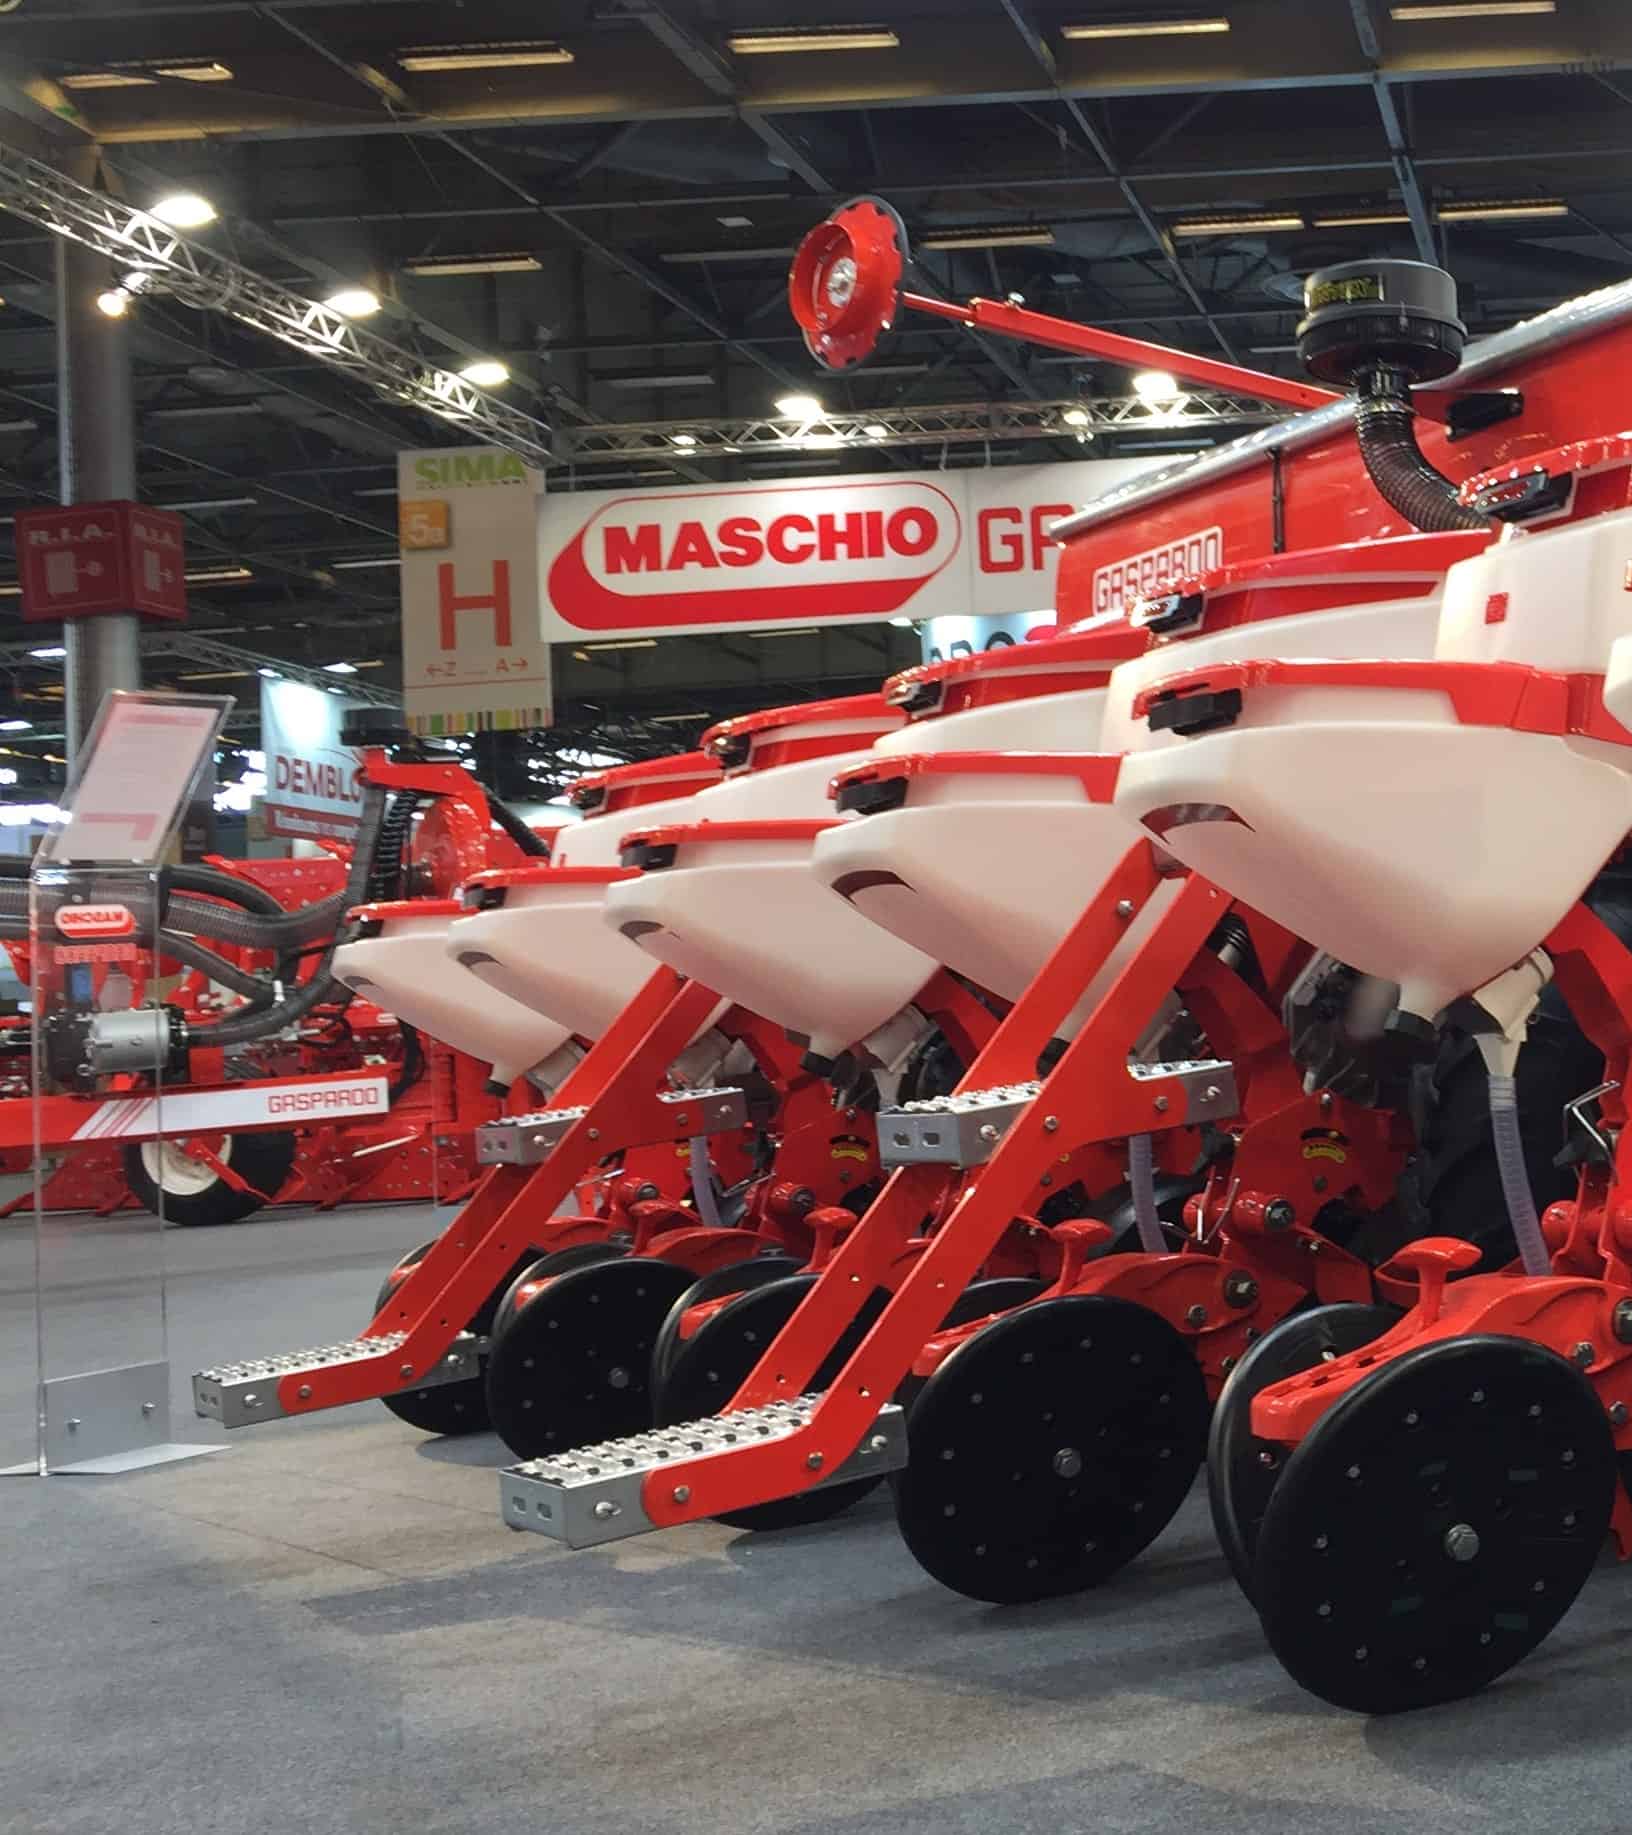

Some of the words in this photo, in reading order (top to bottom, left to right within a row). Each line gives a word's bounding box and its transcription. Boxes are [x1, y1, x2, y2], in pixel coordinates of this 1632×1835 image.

[415, 453, 528, 483] SIMA
[602, 506, 939, 574] MASCHIO
[438, 559, 512, 651] H
[267, 1086, 379, 1114] GASPARDO
